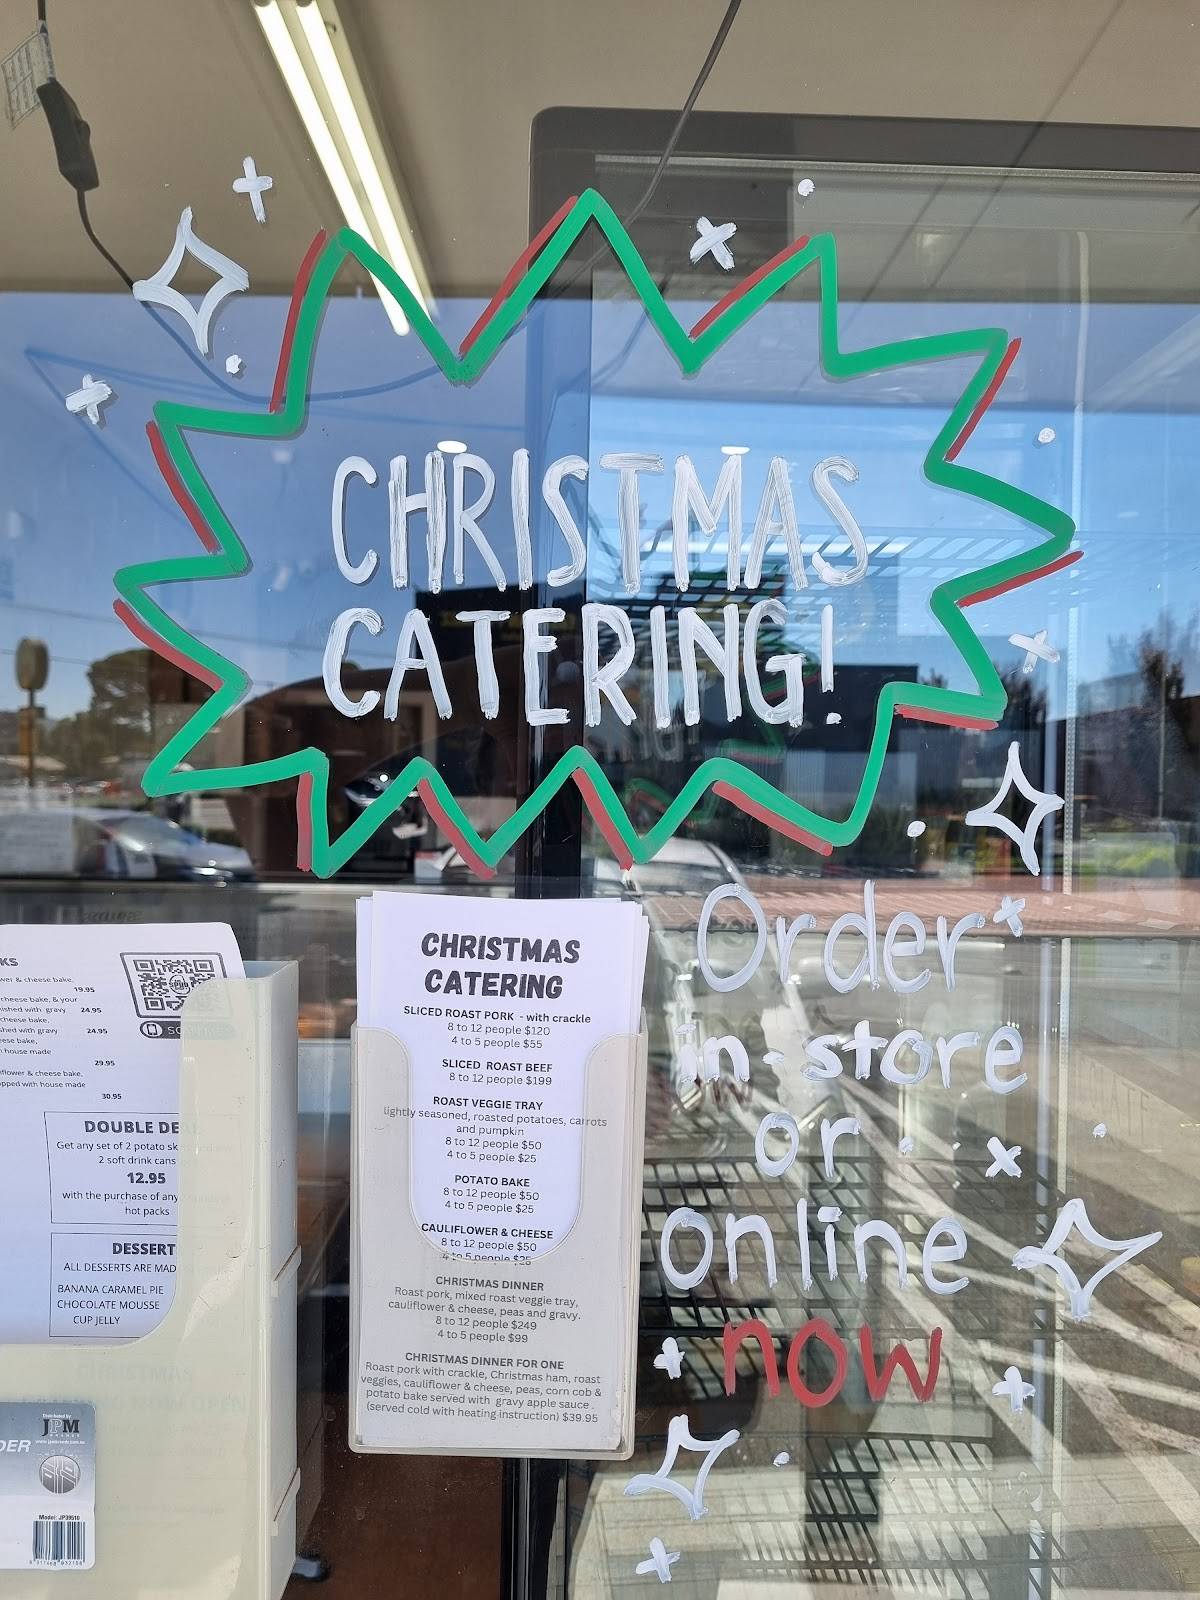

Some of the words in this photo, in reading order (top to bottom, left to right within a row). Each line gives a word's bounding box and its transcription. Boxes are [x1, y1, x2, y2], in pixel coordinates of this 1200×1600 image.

[332, 448, 869, 593] CHRISTMAS
[323, 599, 841, 728] CATERING!
[699, 879, 986, 994] Order
[421, 932, 580, 964] CHRISTMAS
[424, 969, 563, 999] CATERING
[404, 1005, 442, 1017] SLICED
[445, 1008, 482, 1019] ROAST
[484, 1011, 514, 1021] PORK
[526, 1013, 549, 1022] with
[552, 1014, 591, 1023] crackle
[447, 1022, 454, 1031] 8
[456, 1023, 468, 1032] to
[471, 1024, 482, 1032] 12
[485, 1025, 522, 1036] people
[524, 1025, 550, 1036] $120
[451, 1036, 458, 1044] 4
[461, 1037, 472, 1046] to
[474, 1037, 481, 1046] 5
[483, 1039, 520, 1049] people
[523, 1039, 543, 1049] $55
[442, 1059, 481, 1069] SLICED
[486, 1061, 523, 1071] ROAST
[525, 1063, 552, 1072] BEEF
[449, 1072, 455, 1081] 8
[458, 1074, 469, 1082] to
[472, 1073, 484, 1083] 12
[486, 1075, 523, 1086] people
[526, 1075, 552, 1086] $199
[433, 1096, 469, 1107] ROAST
[471, 1099, 512, 1109] VEGGIE
[515, 1101, 543, 1110] TRAY
[384, 1106, 416, 1119] lightly
[473, 1113, 514, 1123] roasted
[569, 1117, 607, 1127] carrots
[84, 1120, 154, 1134] DOUBLE
[456, 1124, 476, 1134] and
[479, 1127, 524, 1137] pumpkin
[56, 1141, 74, 1149] Get
[76, 1143, 94, 1152] any
[113, 1141, 123, 1150] of
[125, 1142, 131, 1150] 2
[134, 1143, 165, 1152] potato
[445, 1137, 452, 1145] 8
[454, 1138, 465, 1146] to
[468, 1138, 480, 1147] 12
[482, 1140, 519, 1151] people
[521, 1140, 542, 1150] $50
[754, 1112, 861, 1178] or
[99, 1156, 104, 1164] 2
[107, 1155, 125, 1164] soft
[128, 1156, 152, 1165] drink
[127, 1172, 166, 1184] 12.95
[455, 1175, 498, 1186] POTATO
[501, 1177, 530, 1187] BAKE
[62, 1191, 83, 1199] with
[85, 1191, 101, 1200] the
[104, 1191, 148, 1202] purchase
[150, 1192, 160, 1201] of
[162, 1194, 178, 1203] any
[125, 1206, 140, 1215] hot
[143, 1207, 170, 1218] packs
[421, 1223, 498, 1236] CAULIFLOWER
[501, 1228, 508, 1237] &
[511, 1228, 553, 1239] CHEESE
[441, 1237, 447, 1246] 8
[450, 1239, 461, 1247] to
[463, 1239, 475, 1248] 12
[478, 1241, 514, 1251] people
[517, 1241, 537, 1252] $50
[660, 1198, 969, 1295] online
[63, 1262, 81, 1271] ALL
[84, 1263, 131, 1272] DESSERTS
[133, 1263, 151, 1272] ARE
[58, 1284, 99, 1294] BANANA
[102, 1285, 147, 1294] CARAMEL
[150, 1285, 164, 1295] PIE
[436, 1276, 499, 1289] CHRISTMAS
[502, 1280, 544, 1291] DINNER
[395, 1286, 424, 1297] Roast
[455, 1291, 486, 1301] mixed
[489, 1295, 516, 1303] roast
[518, 1296, 552, 1307] veggie
[57, 1300, 116, 1309] CHOCOLATE
[119, 1301, 160, 1310] MOUSSE
[388, 1300, 446, 1312] cauliflower
[448, 1303, 455, 1313] &
[499, 1308, 524, 1318] peas
[526, 1309, 546, 1318] and
[73, 1315, 93, 1324] CUP
[95, 1316, 120, 1326] JELLY
[435, 1315, 442, 1325] 8
[444, 1317, 456, 1326] to
[458, 1317, 470, 1327] 12
[472, 1319, 509, 1330] people
[511, 1319, 537, 1331] $249
[437, 1329, 444, 1338] 4
[446, 1330, 458, 1339] to
[460, 1330, 467, 1340] 5
[469, 1332, 506, 1343] people
[508, 1333, 528, 1343] $99
[405, 1352, 469, 1365] CHRISTMAS
[471, 1356, 513, 1367] DINNER
[516, 1359, 538, 1368] FOR
[540, 1360, 564, 1370] ONE
[723, 1318, 942, 1408] now
[366, 1361, 394, 1373] Roast
[397, 1365, 420, 1375] pork
[423, 1366, 445, 1376] with
[490, 1370, 543, 1381] Christmas
[574, 1376, 601, 1384] roast
[403, 1379, 462, 1390] cauliflower
[464, 1382, 471, 1391] &
[545, 1388, 570, 1396] corn
[572, 1387, 592, 1397] cob
[594, 1388, 601, 1397] &
[366, 1389, 401, 1399] potato
[403, 1390, 428, 1401] bake
[430, 1393, 465, 1404] served
[468, 1395, 490, 1405] with
[495, 1397, 524, 1409] gravy
[527, 1398, 556, 1409] apple
[366, 1401, 405, 1413] (served
[407, 1405, 430, 1415] cold
[432, 1406, 455, 1416] with
[457, 1407, 497, 1421] heating
[499, 1408, 559, 1422] instruction)
[562, 1412, 598, 1423] $39.95
[41, 1419, 80, 1437] JPM
